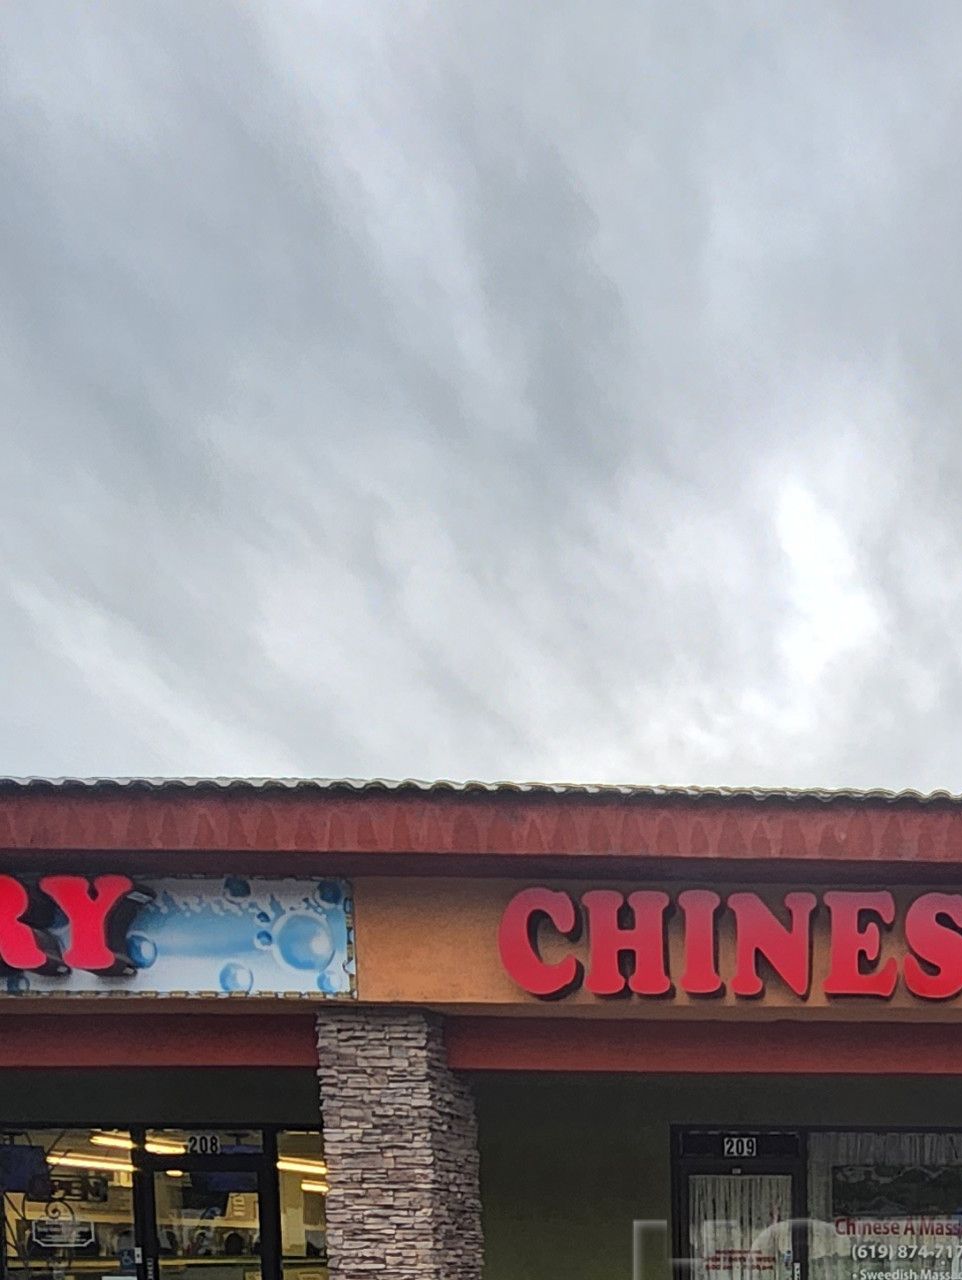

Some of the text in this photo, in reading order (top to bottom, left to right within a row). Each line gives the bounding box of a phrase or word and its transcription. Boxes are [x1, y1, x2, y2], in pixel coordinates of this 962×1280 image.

[188, 1136, 220, 1154] 208
[725, 1138, 755, 1156] 209
[835, 1216, 900, 1237] Chinese
[903, 1217, 915, 1236] A
[852, 1243, 894, 1261] (619)
